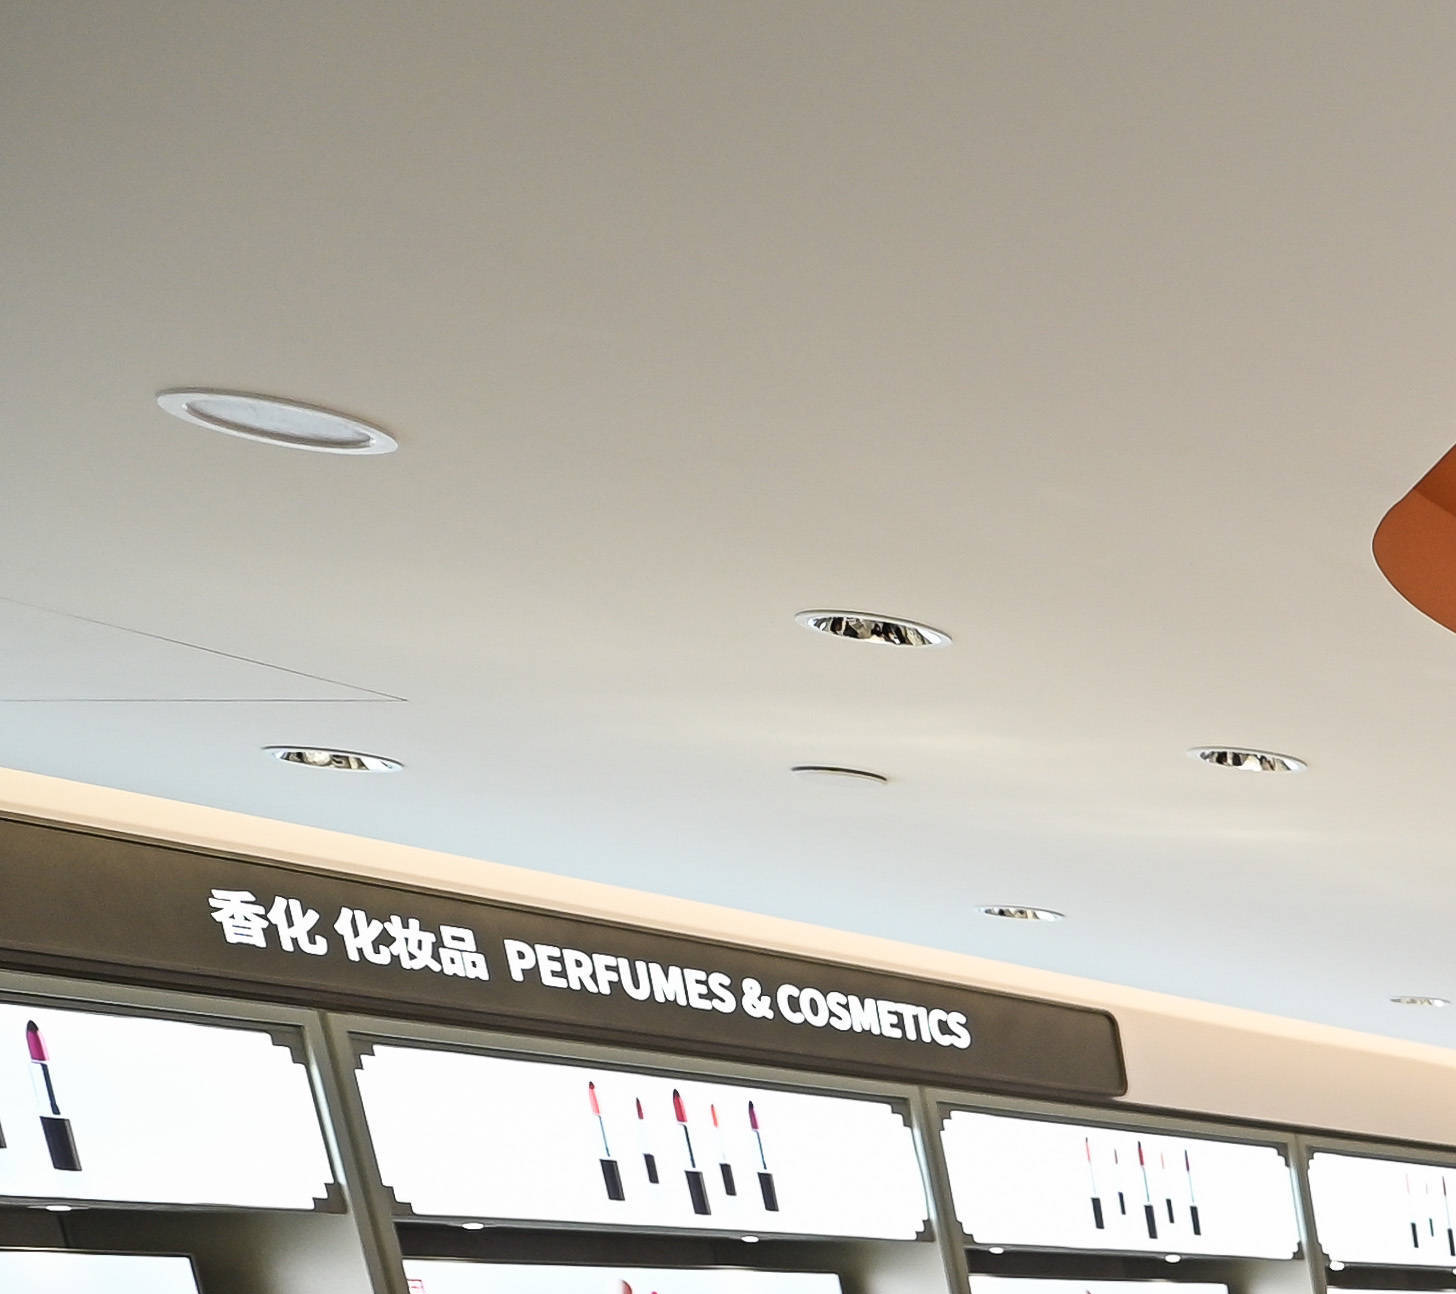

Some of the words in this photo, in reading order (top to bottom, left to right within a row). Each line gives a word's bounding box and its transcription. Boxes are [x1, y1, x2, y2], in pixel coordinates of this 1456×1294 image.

[207, 888, 329, 956] 香化
[333, 906, 491, 982] 化妆品
[503, 939, 737, 1014] PERFUMES
[741, 977, 775, 1020] &
[776, 983, 972, 1050] COSMETICS
